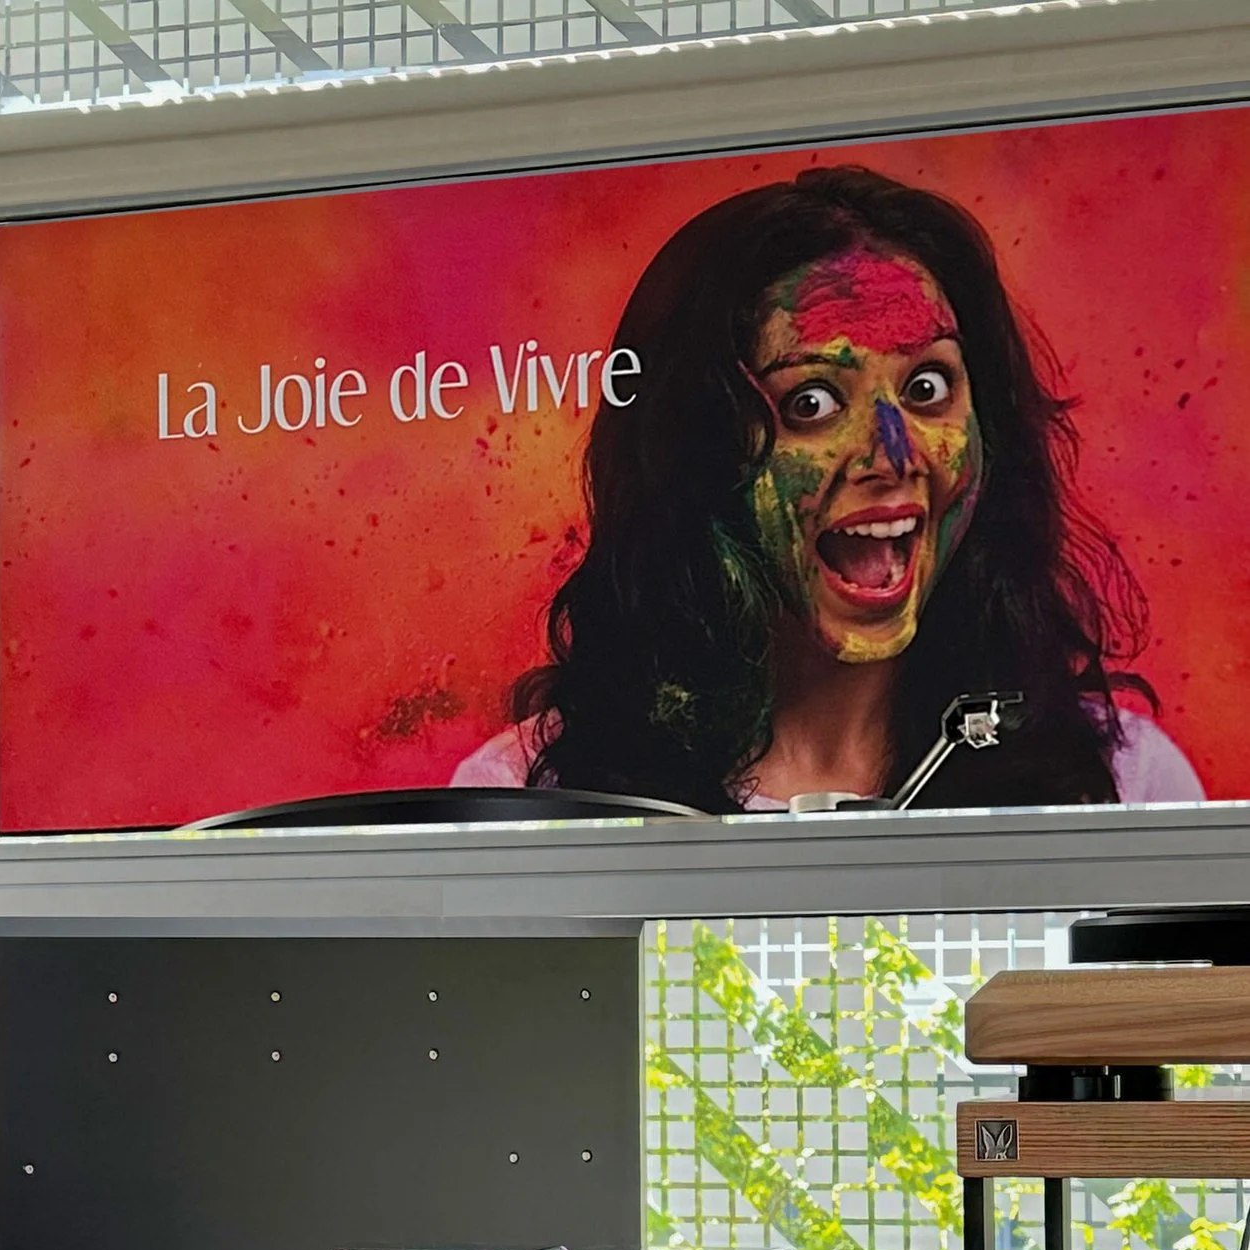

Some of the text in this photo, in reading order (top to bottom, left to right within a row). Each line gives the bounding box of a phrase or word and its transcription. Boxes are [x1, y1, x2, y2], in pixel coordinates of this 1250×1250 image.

[157, 339, 642, 440] La Joie de Vivre
